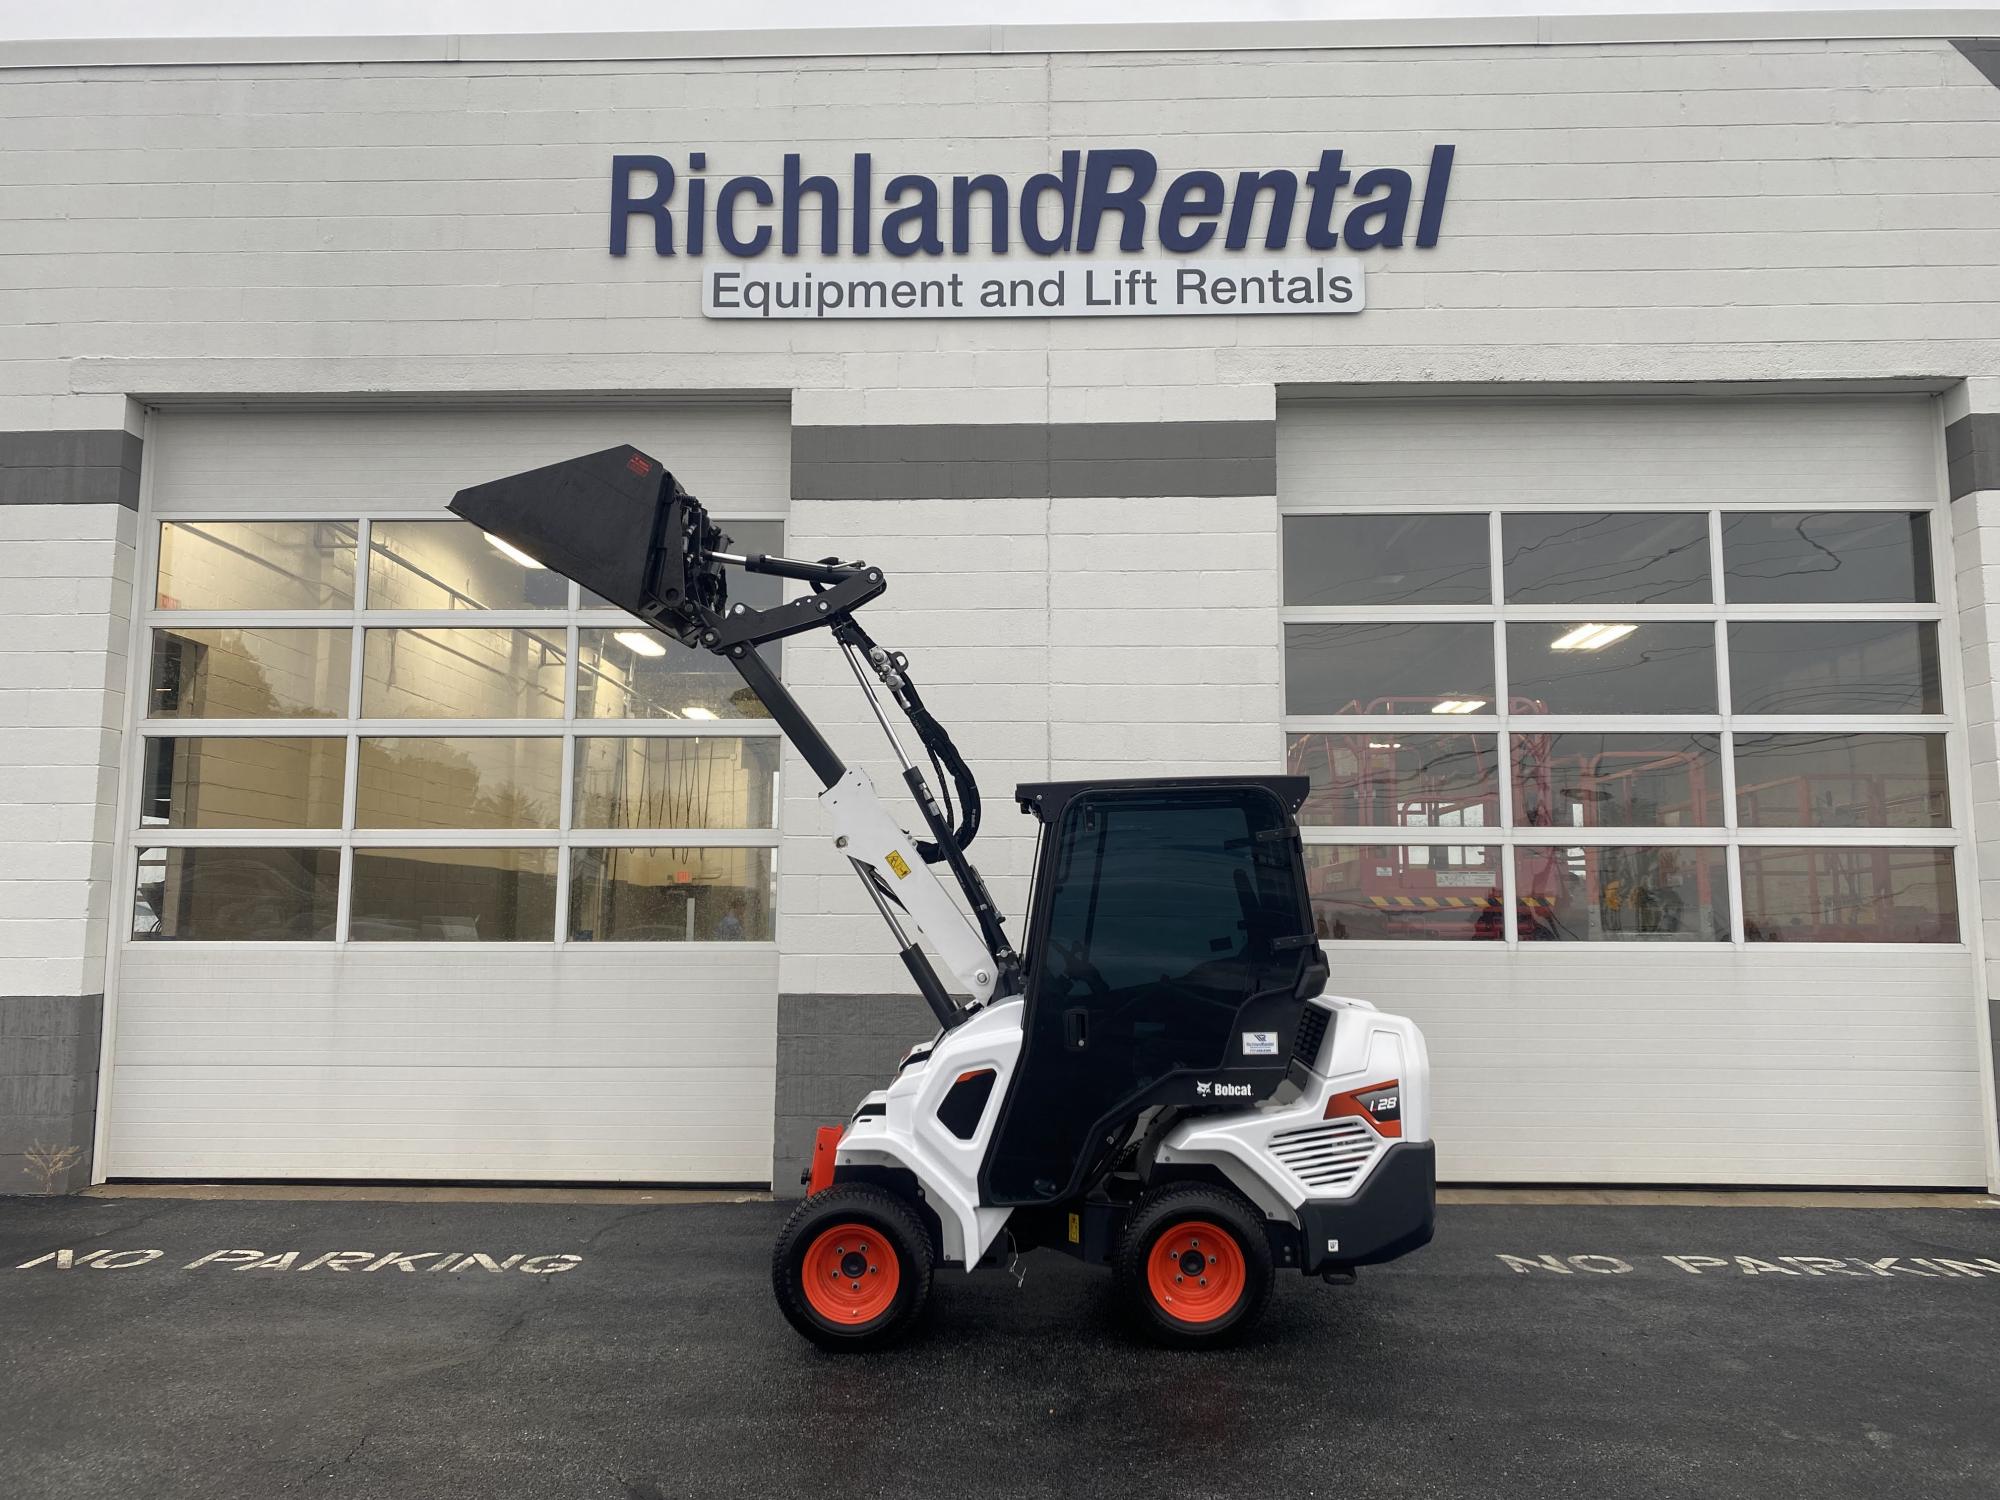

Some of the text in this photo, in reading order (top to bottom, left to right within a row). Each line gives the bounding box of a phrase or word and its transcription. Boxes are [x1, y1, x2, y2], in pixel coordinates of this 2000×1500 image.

[609, 145, 1455, 257] RichlandRental
[712, 267, 1353, 319] Equipment and Lift Rentals
[1214, 1083, 1252, 1097] Bobcat
[15, 1249, 583, 1274] NO PARKING
[1495, 1254, 1635, 1274] NO
